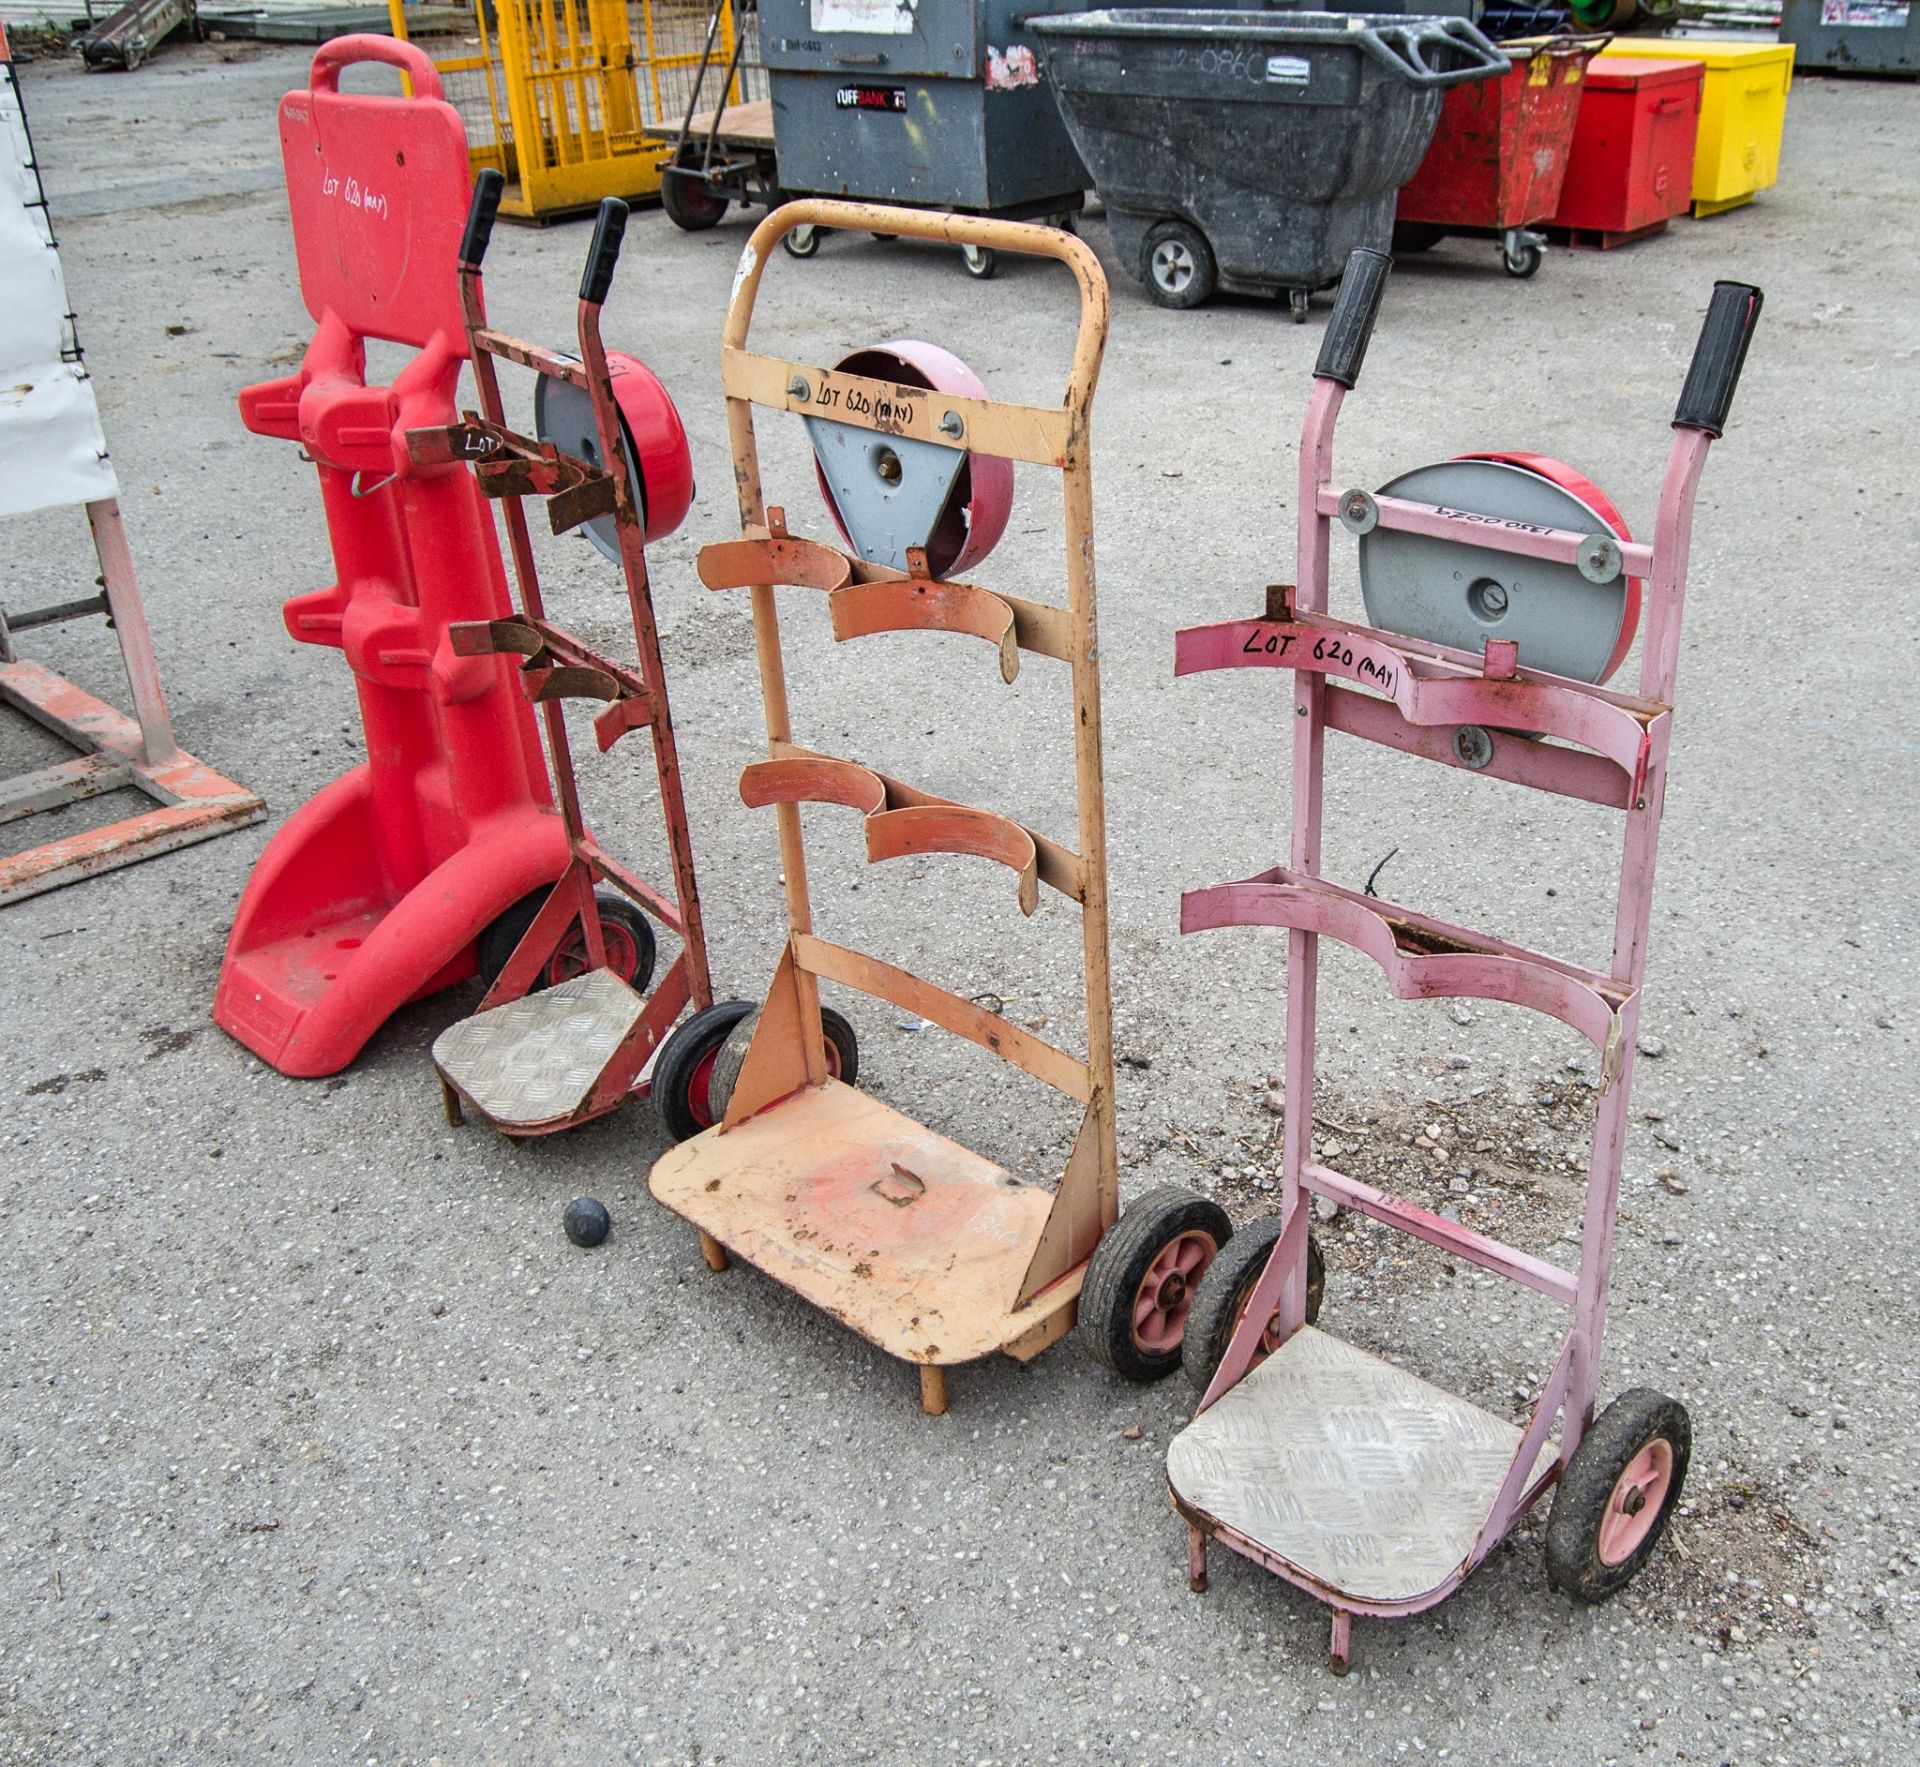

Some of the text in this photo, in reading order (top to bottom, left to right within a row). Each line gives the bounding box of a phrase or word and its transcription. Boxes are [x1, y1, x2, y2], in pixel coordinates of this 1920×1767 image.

[345, 176, 361, 208] 620
[816, 381, 841, 407] LOT
[846, 388, 871, 415] 620
[1243, 629, 1296, 657] LOT
[1313, 637, 1353, 667] 620
